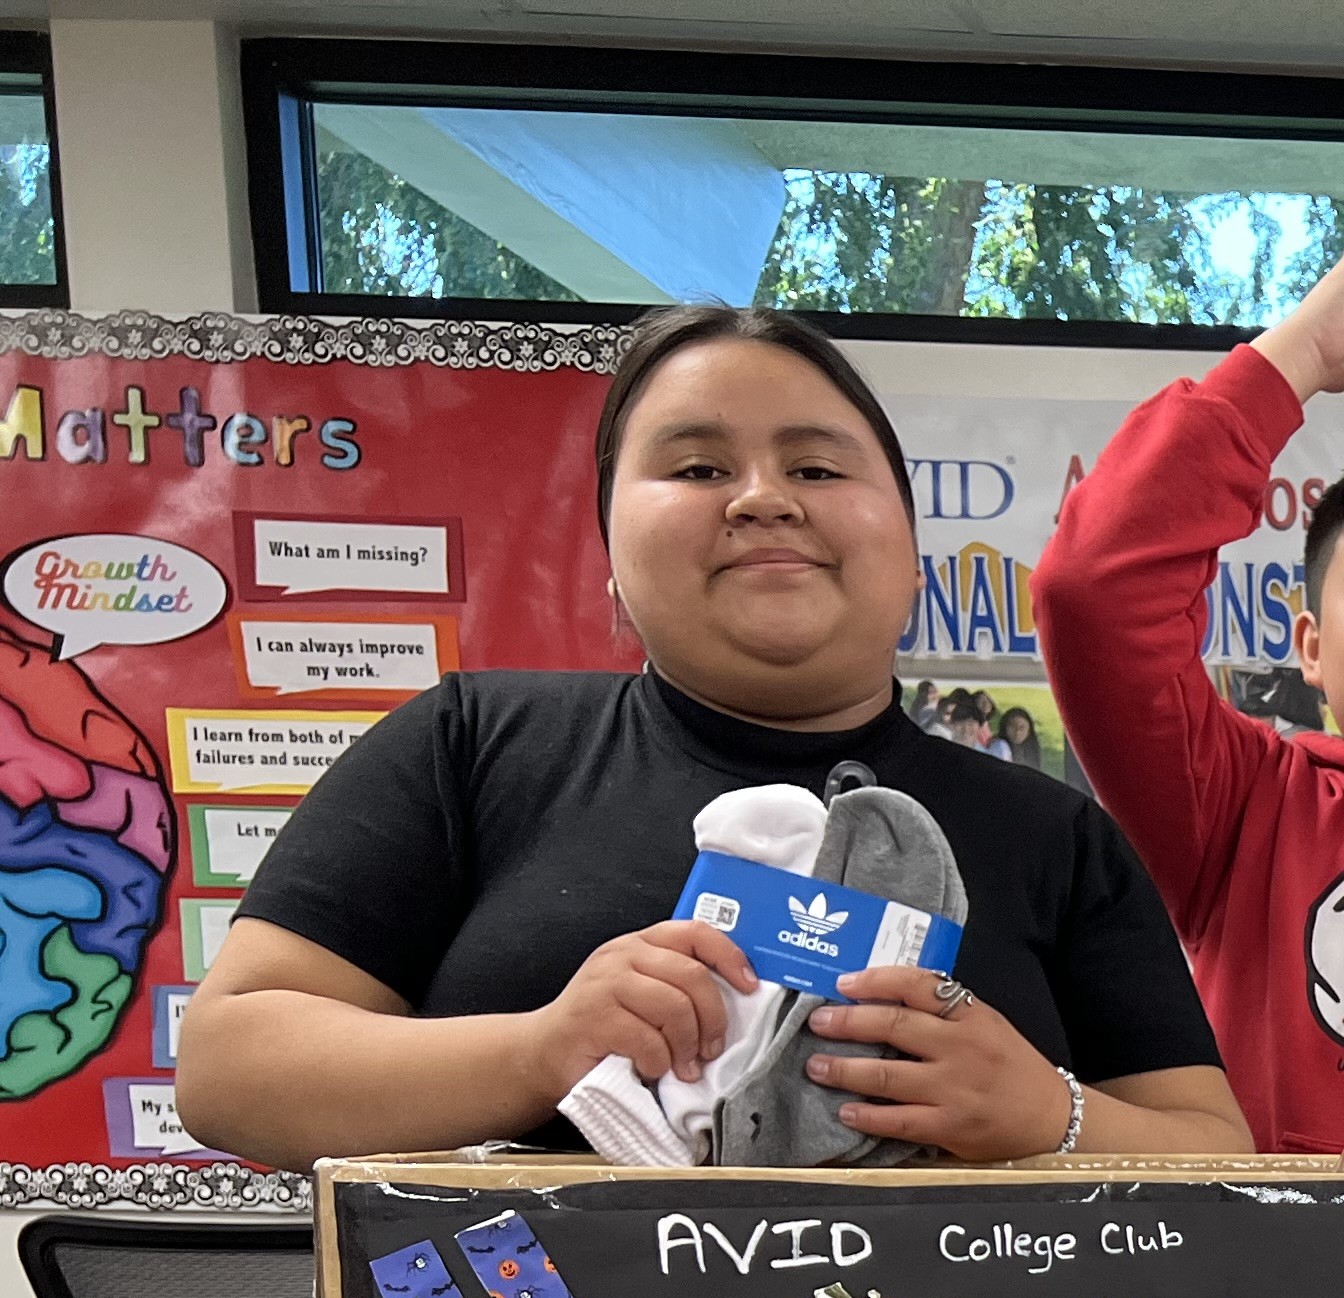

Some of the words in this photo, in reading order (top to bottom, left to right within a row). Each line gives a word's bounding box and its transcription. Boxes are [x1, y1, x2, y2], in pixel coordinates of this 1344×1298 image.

[268, 540, 310, 559] What
[315, 546, 341, 560] am
[345, 543, 351, 560] I
[356, 546, 428, 567] missing?
[35, 550, 178, 582] Growth
[34, 578, 193, 614] Mindset
[256, 637, 262, 652] I
[268, 640, 294, 653] can
[299, 638, 354, 657] always
[358, 638, 425, 658] improve
[306, 665, 330, 681] my
[335, 662, 380, 678] work.
[193, 726, 198, 741] I
[204, 727, 243, 742] learn
[249, 728, 284, 743] from
[289, 728, 324, 744] both
[329, 728, 344, 744] of
[195, 749, 255, 765] failures
[260, 751, 287, 766] and
[236, 822, 260, 838] Let
[777, 930, 839, 958] adidas
[141, 1099, 162, 1116] My
[658, 1213, 874, 1276] AVID
[938, 1224, 1078, 1274] College
[1100, 1222, 1184, 1256] Club
